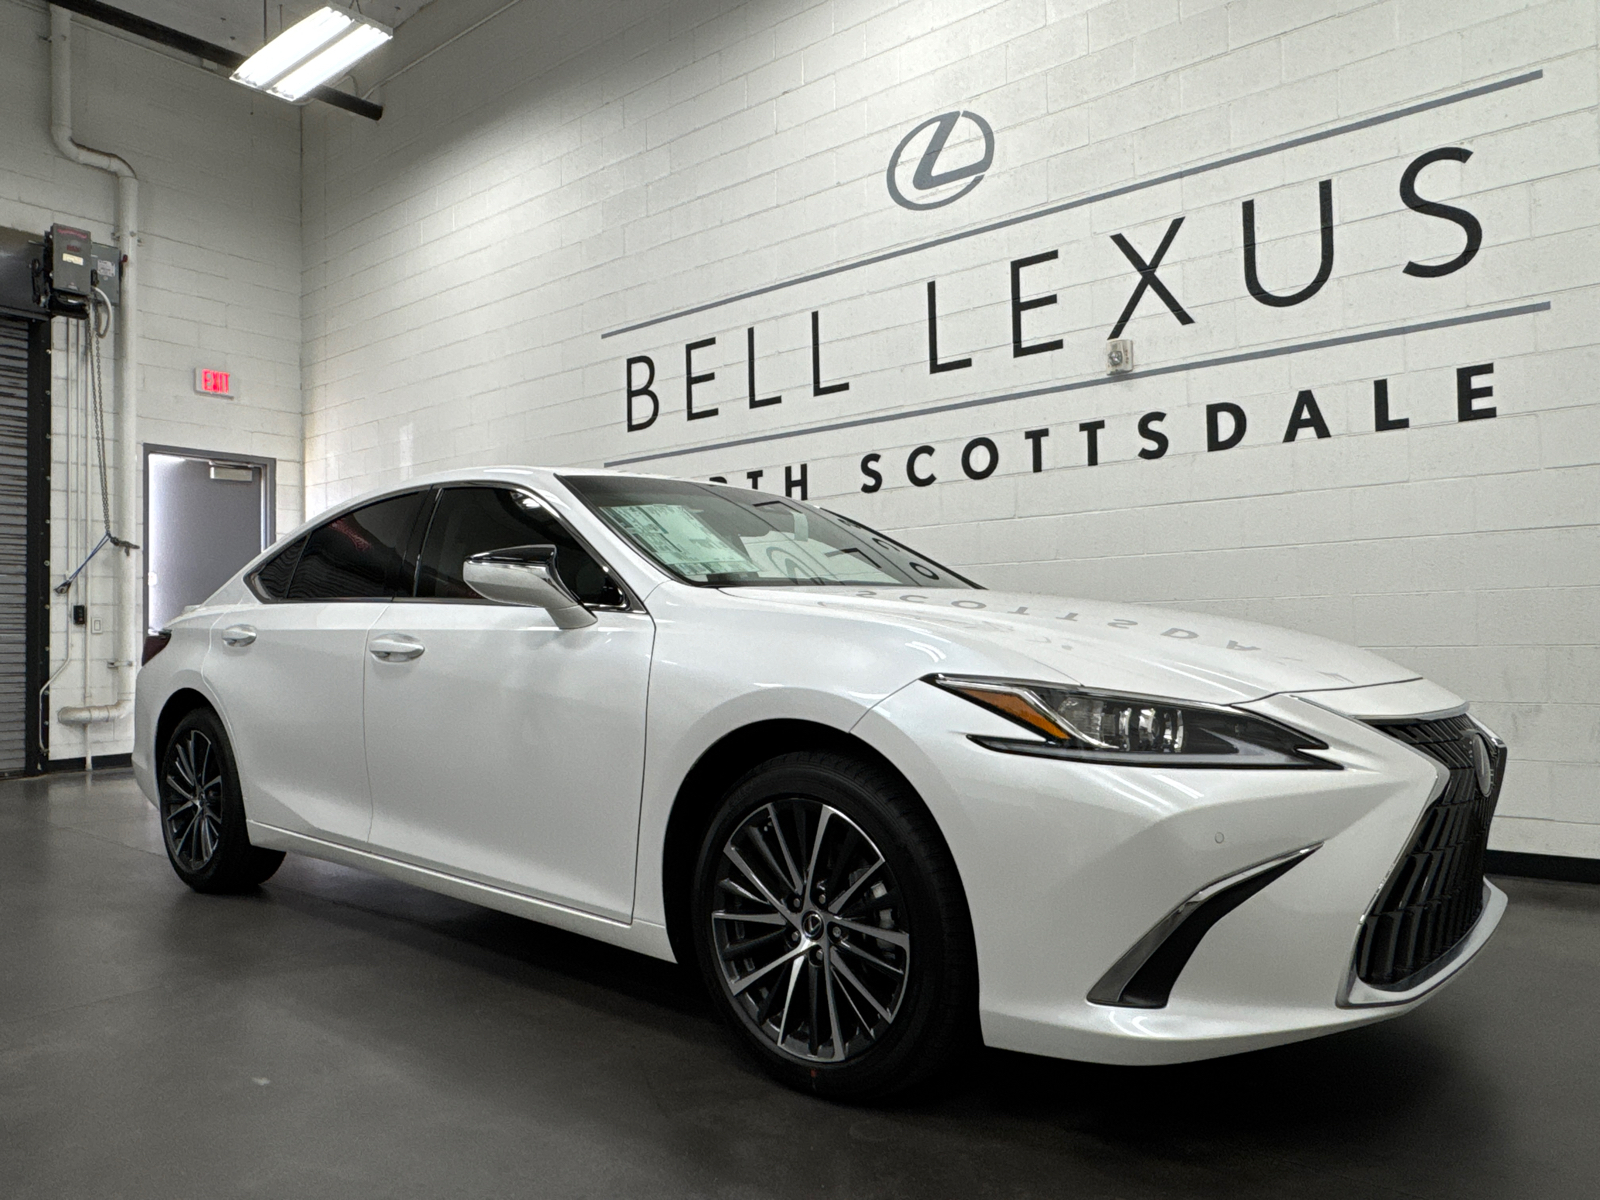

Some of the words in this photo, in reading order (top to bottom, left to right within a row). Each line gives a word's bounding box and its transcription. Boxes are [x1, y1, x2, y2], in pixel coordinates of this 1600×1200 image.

[626, 310, 850, 433] BELL
[927, 146, 1483, 375] LEXUS
[202, 369, 230, 394] EXIT
[860, 362, 1498, 494] SCOTTSDALE
